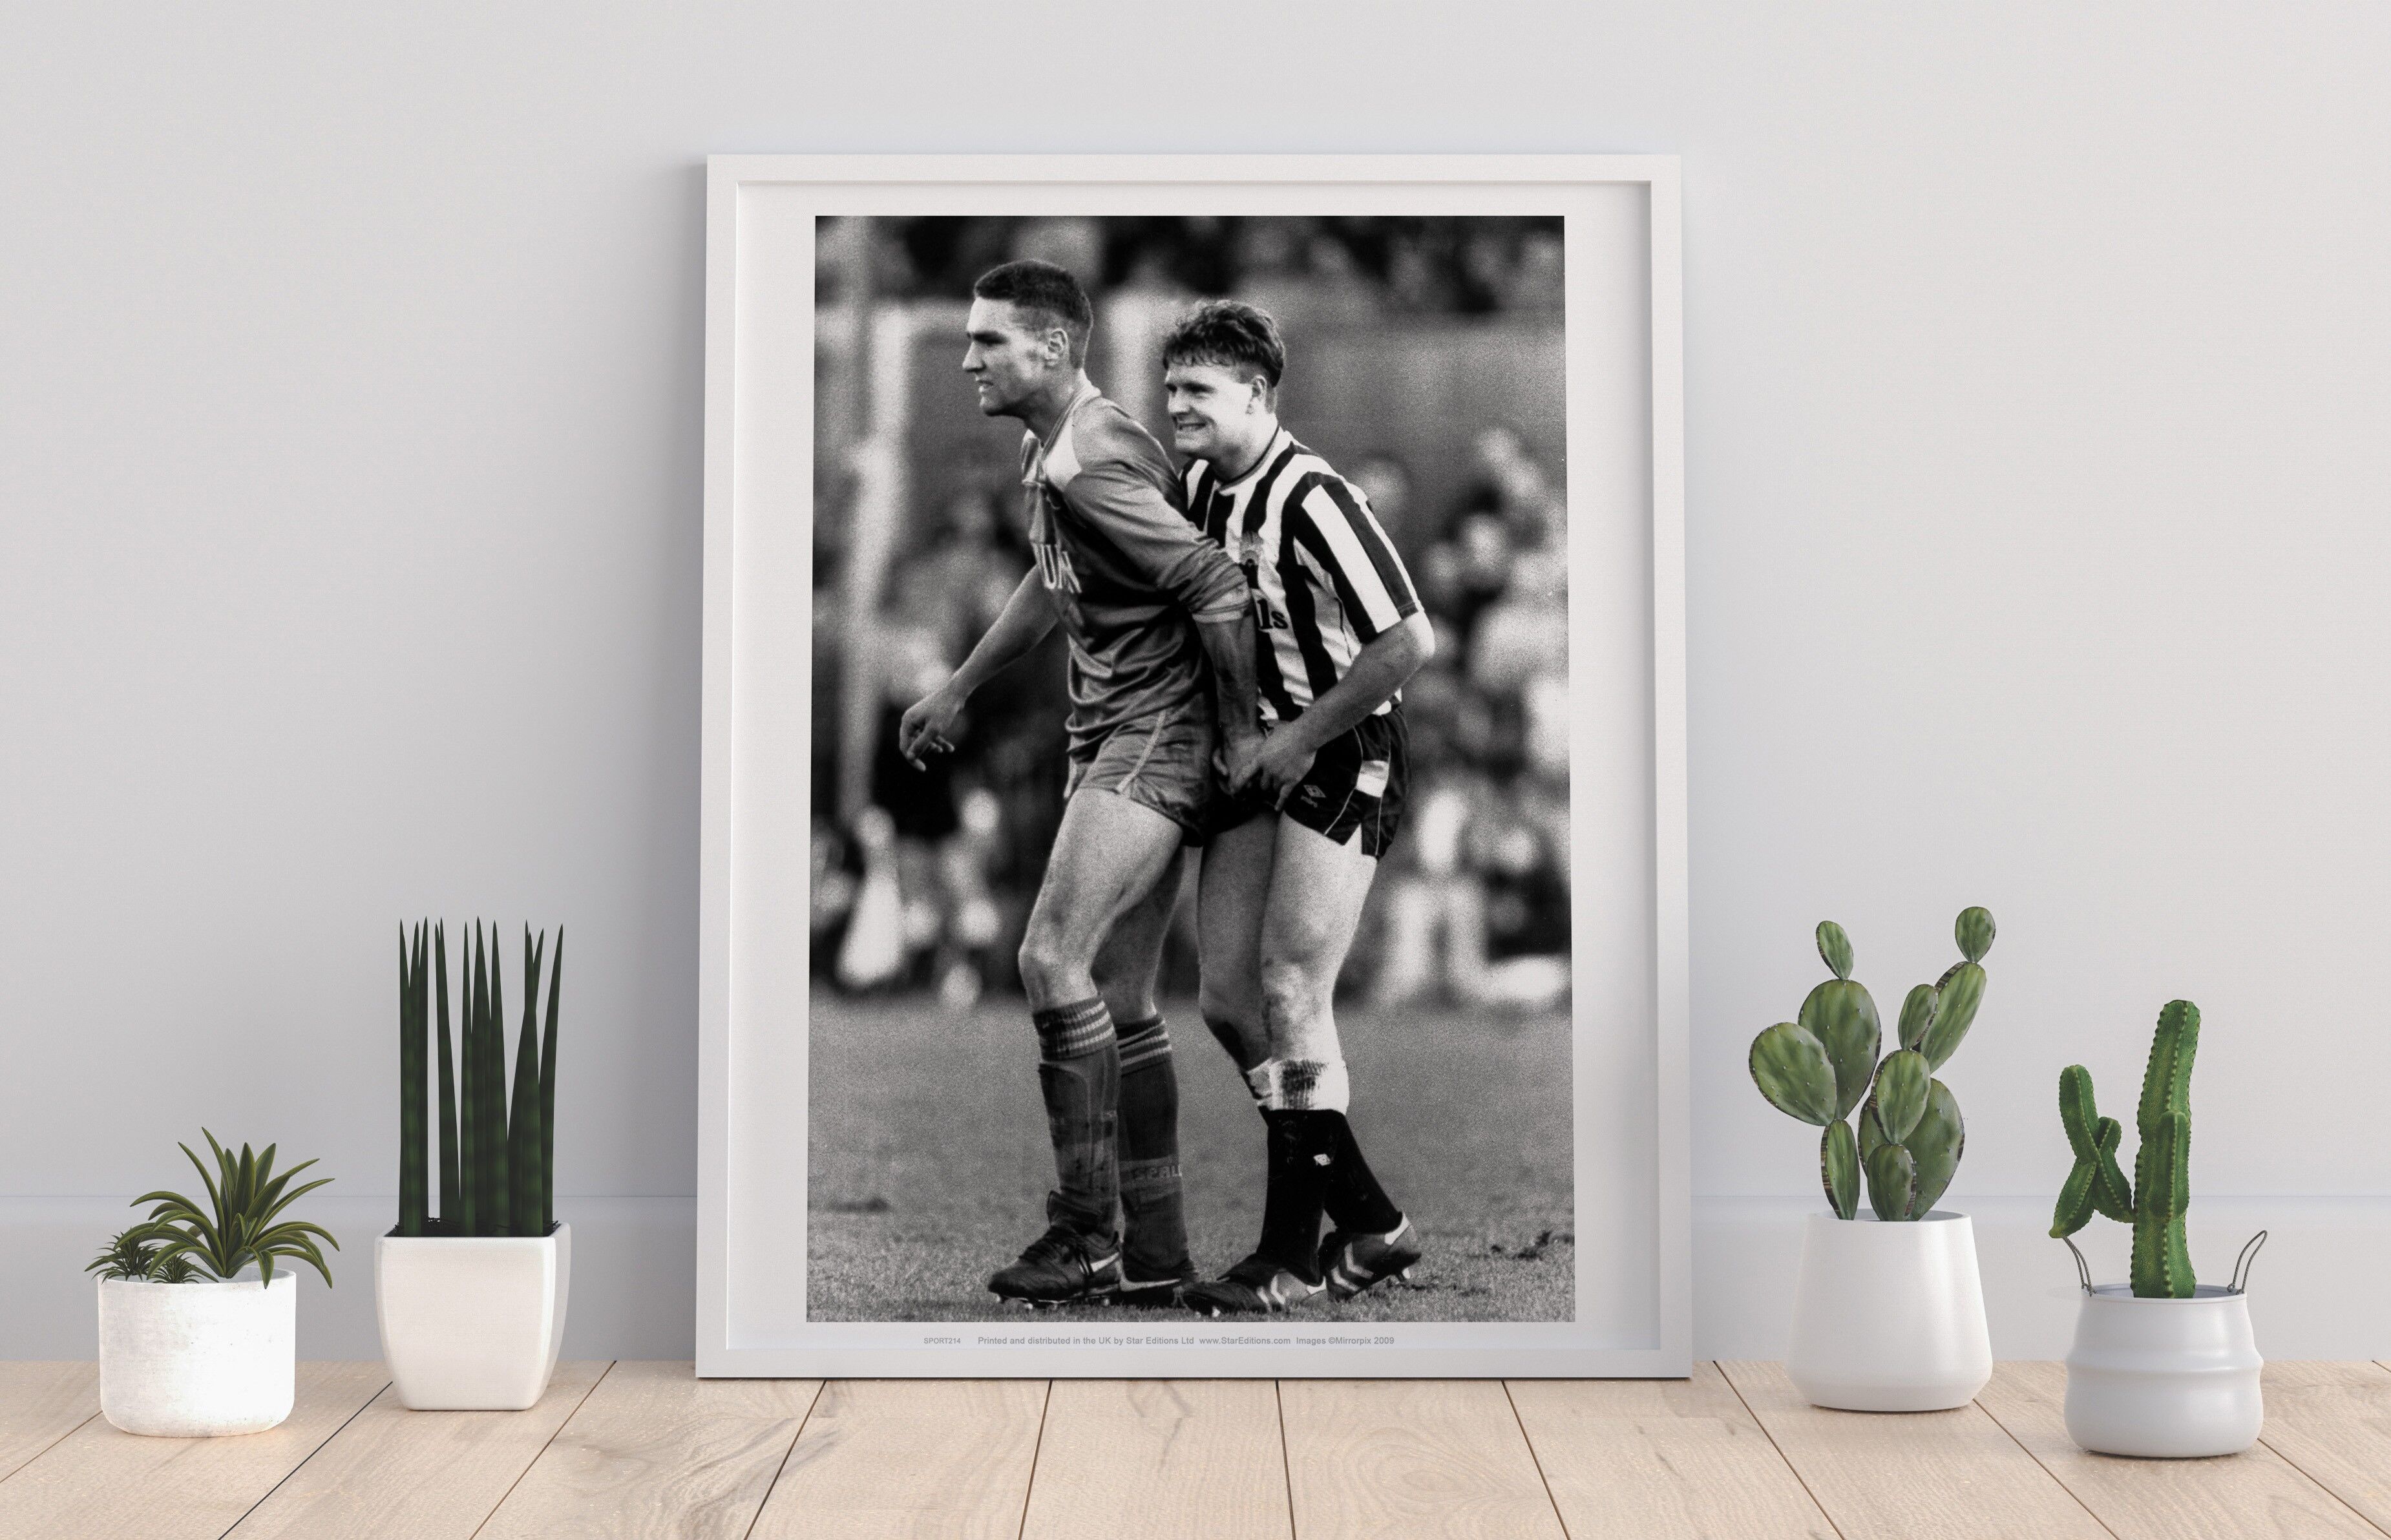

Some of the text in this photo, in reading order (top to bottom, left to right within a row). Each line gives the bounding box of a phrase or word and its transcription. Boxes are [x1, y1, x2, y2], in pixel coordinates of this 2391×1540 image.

[978, 1336, 1007, 1345] Printed
[1009, 1336, 1026, 1345] and
[1027, 1336, 1070, 1345] distributed
[1073, 1336, 1080, 1345] in
[1083, 1336, 1096, 1345] the
[1099, 1336, 1112, 1345] UK
[1114, 1336, 1124, 1347] by
[1126, 1336, 1144, 1345] Star
[1146, 1336, 1179, 1345] Editions
[1181, 1336, 1194, 1345] Ltd
[1199, 1336, 1291, 1345] www.StarEditions.com
[1296, 1336, 1327, 1347] Images
[1374, 1336, 1395, 1345] 2009
